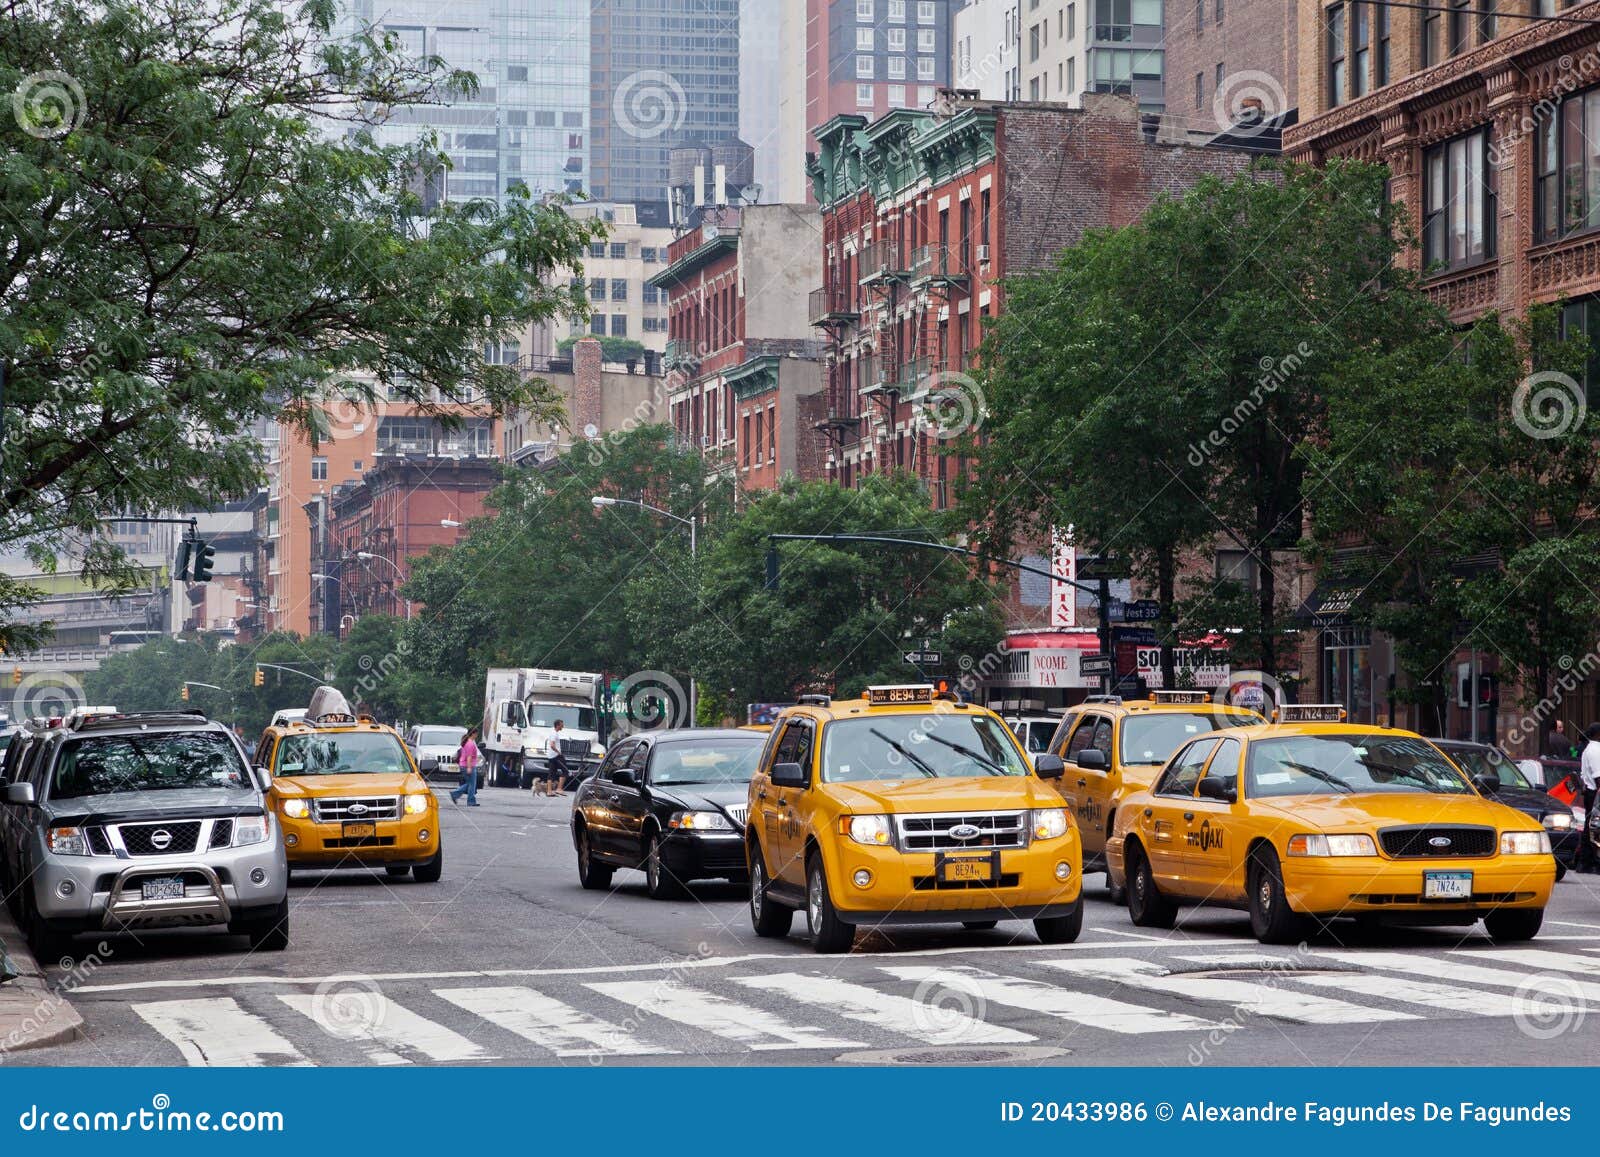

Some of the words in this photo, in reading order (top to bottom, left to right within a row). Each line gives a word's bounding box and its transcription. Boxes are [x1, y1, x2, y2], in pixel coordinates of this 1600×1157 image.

[1034, 656, 1068, 670] INCOME
[1040, 672, 1057, 686] TAX
[890, 690, 915, 701] 8E94
[1171, 695, 1192, 703] 1A59
[1300, 708, 1322, 719] 7N24
